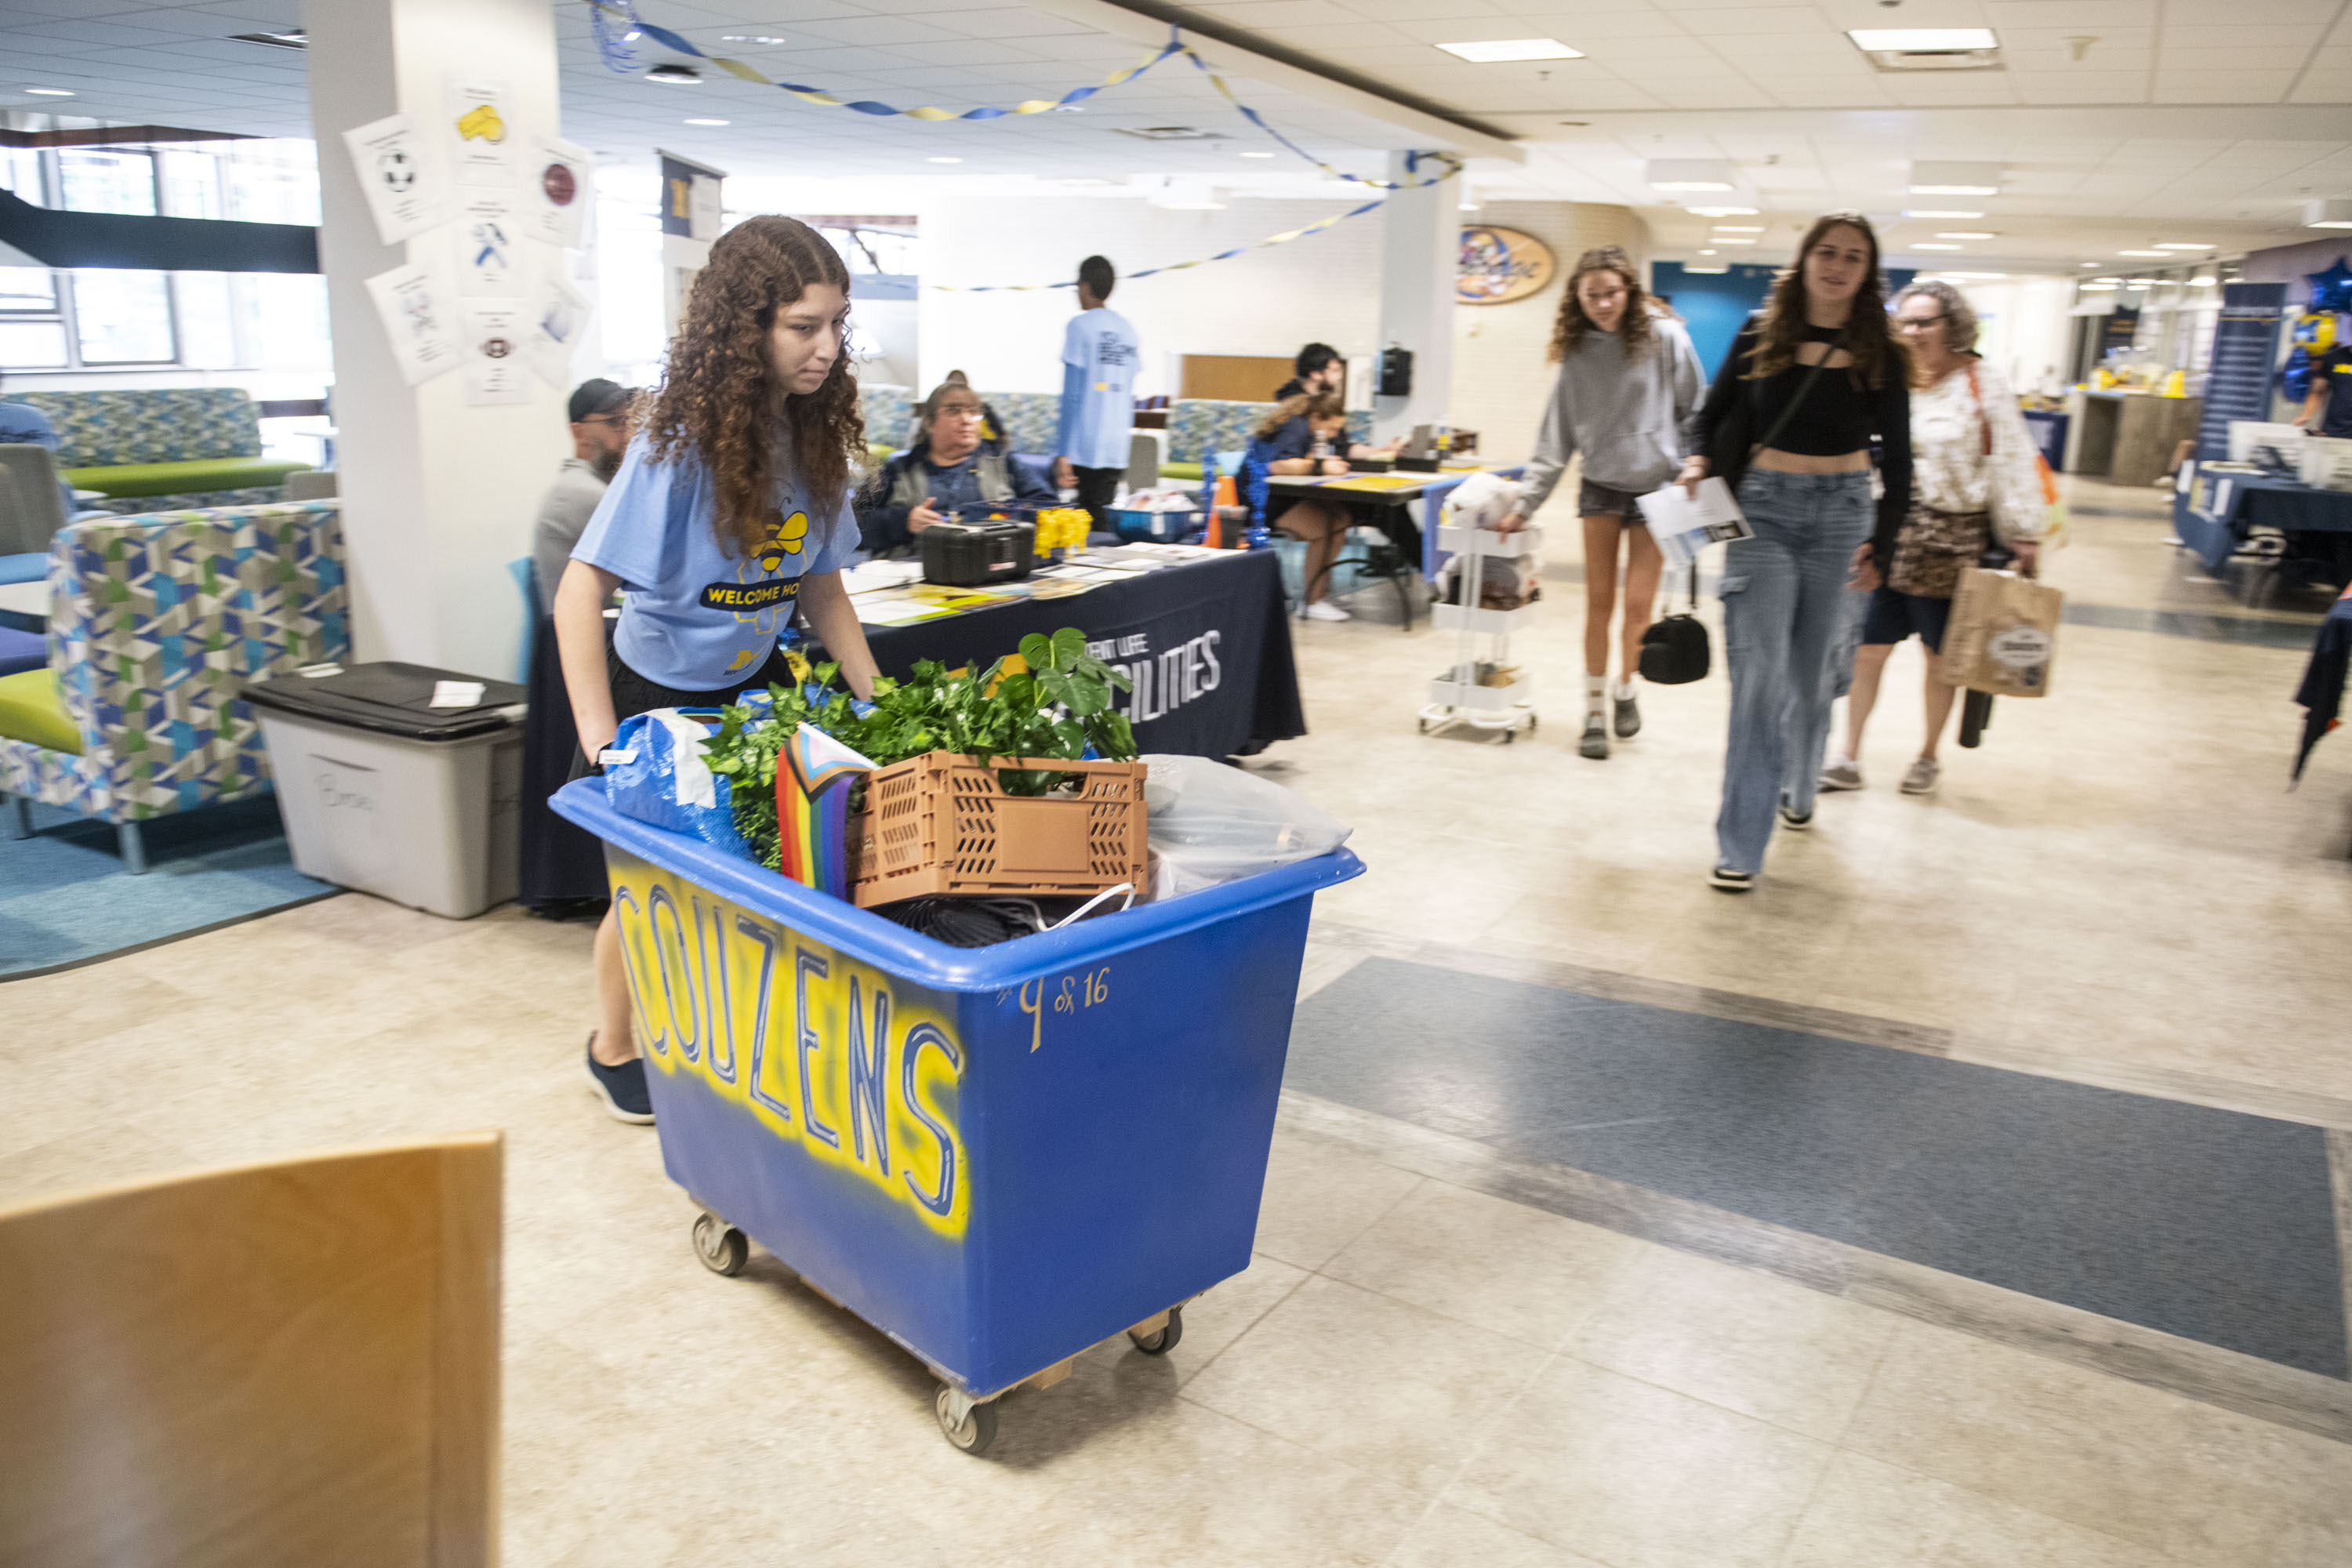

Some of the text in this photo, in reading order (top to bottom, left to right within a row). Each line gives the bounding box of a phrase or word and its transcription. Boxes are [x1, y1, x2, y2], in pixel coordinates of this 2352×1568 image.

[708, 583, 800, 605] WELCOME HO
[1116, 633, 1150, 657] LIFE
[1098, 630, 1221, 724] CILITIES
[1083, 966, 1110, 1008] 16
[615, 884, 964, 1217] COUZENS
